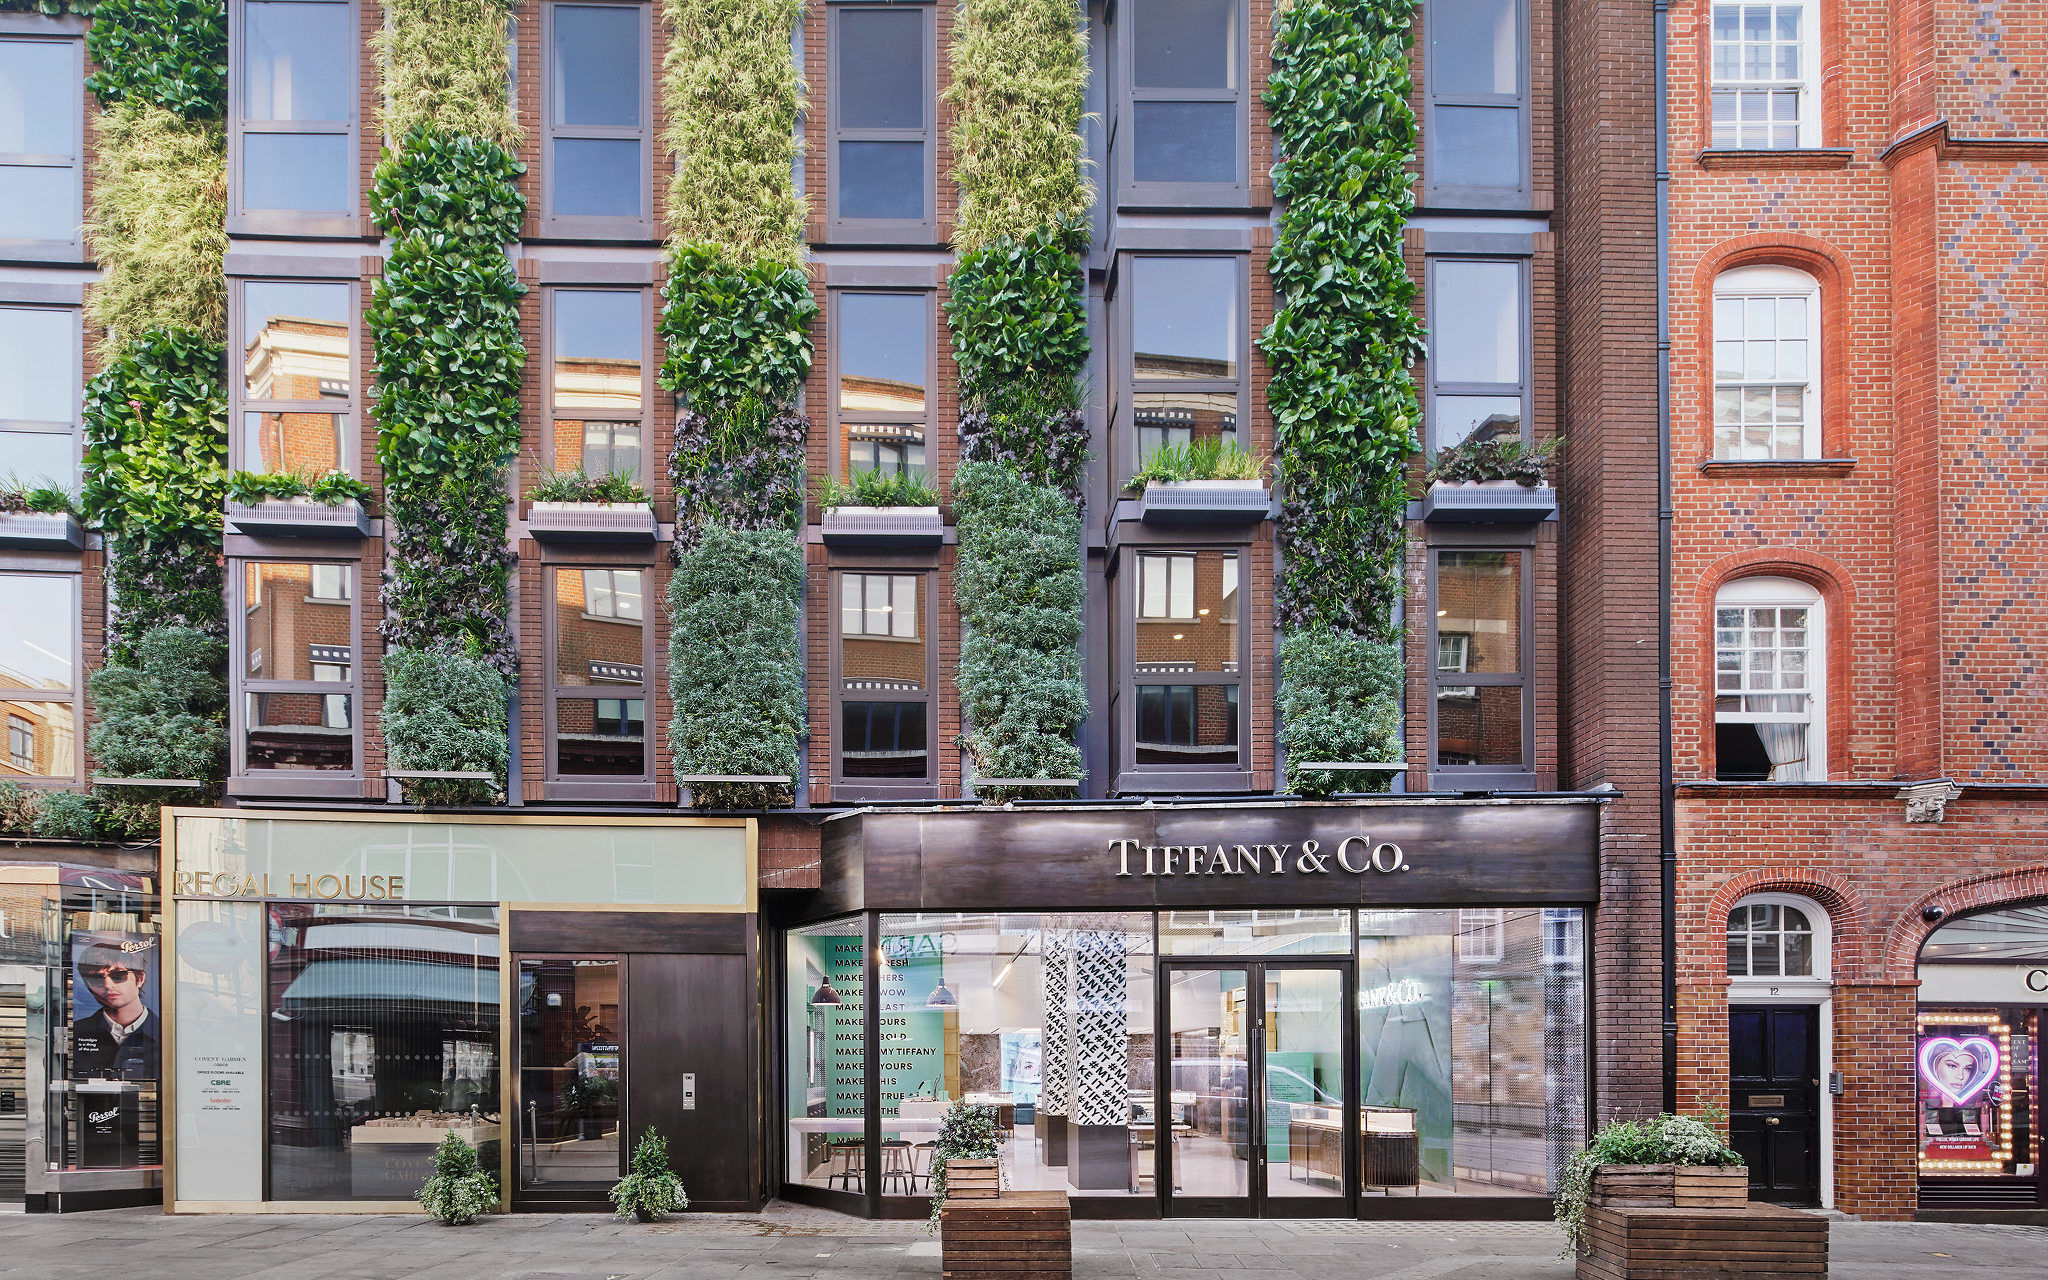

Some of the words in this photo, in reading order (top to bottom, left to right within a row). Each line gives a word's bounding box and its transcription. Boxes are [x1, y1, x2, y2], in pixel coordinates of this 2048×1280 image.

[1108, 839, 1292, 876] TIFFANY
[1296, 839, 1331, 874] &
[174, 870, 278, 898] REGAL
[289, 873, 404, 900] HOUSE
[120, 937, 157, 954] Persol
[1770, 987, 1780, 996] 12
[880, 1018, 906, 1026] OURS
[836, 1048, 864, 1056] MAKE
[881, 1048, 896, 1056] MY
[897, 1048, 937, 1056] TIFFANY
[881, 1092, 905, 1100] TRUE
[88, 1106, 120, 1123] Persol
[881, 1107, 899, 1115] THE
[384, 1160, 434, 1169] COVEN
